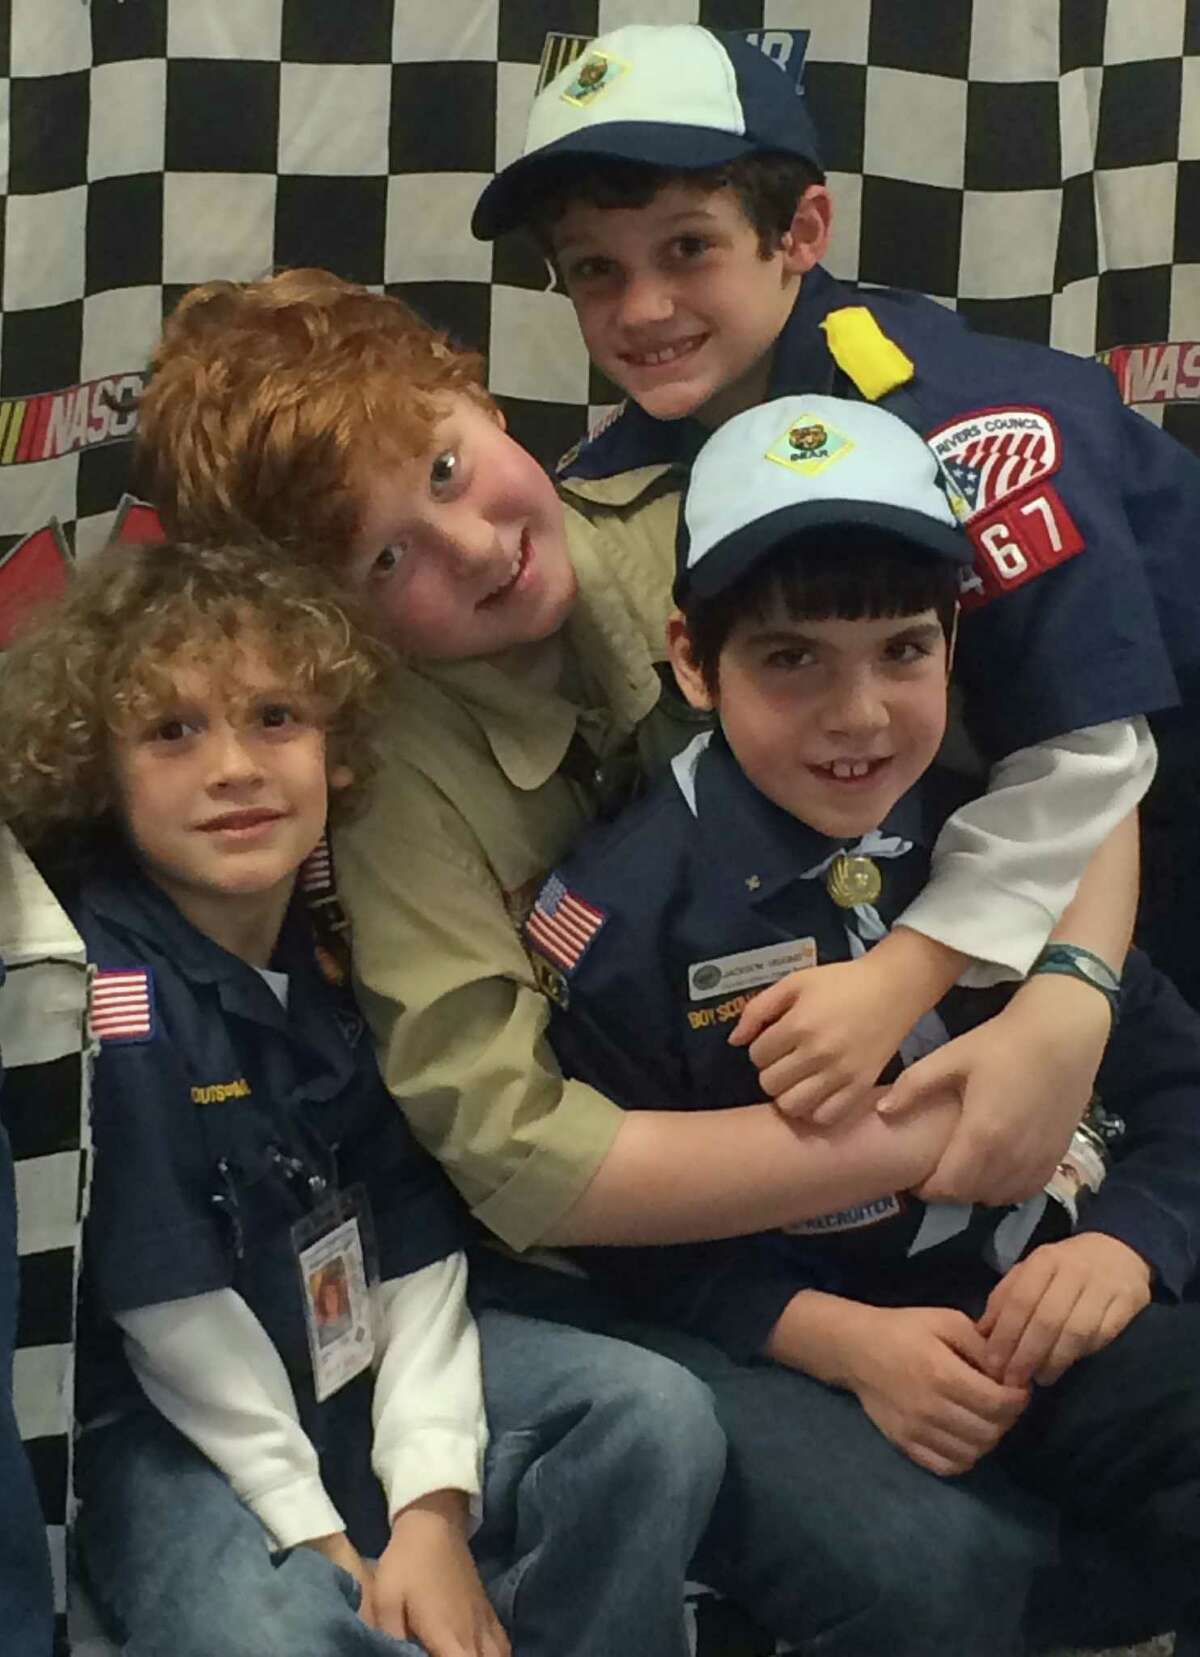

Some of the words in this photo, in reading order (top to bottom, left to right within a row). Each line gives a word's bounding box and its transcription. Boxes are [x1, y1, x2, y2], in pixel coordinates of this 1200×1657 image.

[936, 425, 981, 454] RIVERS
[984, 417, 1043, 432] COUNCIL
[688, 1009, 717, 1029] BOY
